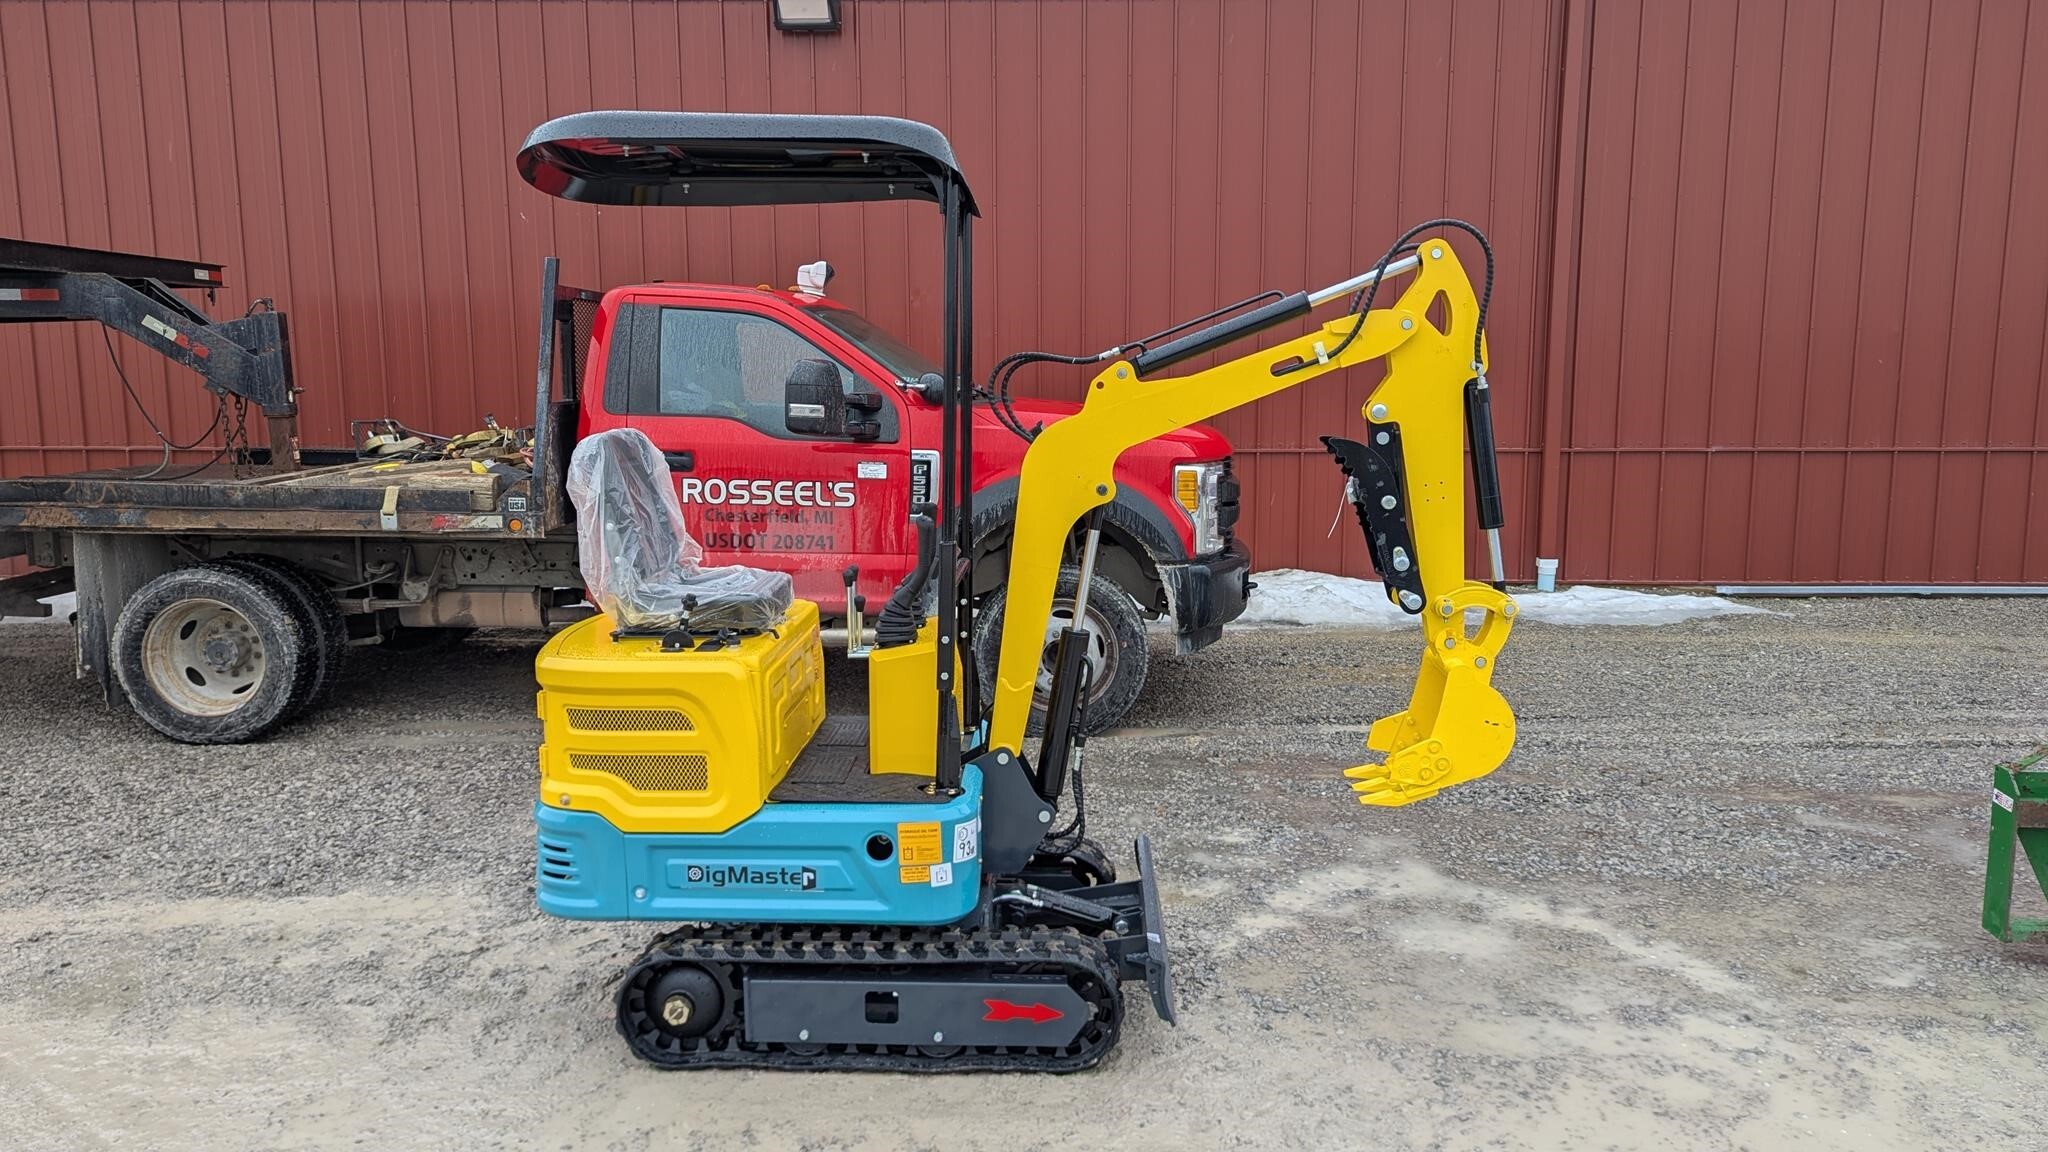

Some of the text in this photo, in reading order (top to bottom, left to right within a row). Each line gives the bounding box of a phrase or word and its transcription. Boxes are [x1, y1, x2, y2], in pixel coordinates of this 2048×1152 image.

[682, 478, 856, 508] ROSSEEL'S
[510, 501, 525, 510] USA
[705, 508, 834, 526] Chesterfield, MI
[705, 532, 834, 550] USDOT 208741
[687, 865, 817, 891] DigMaster
